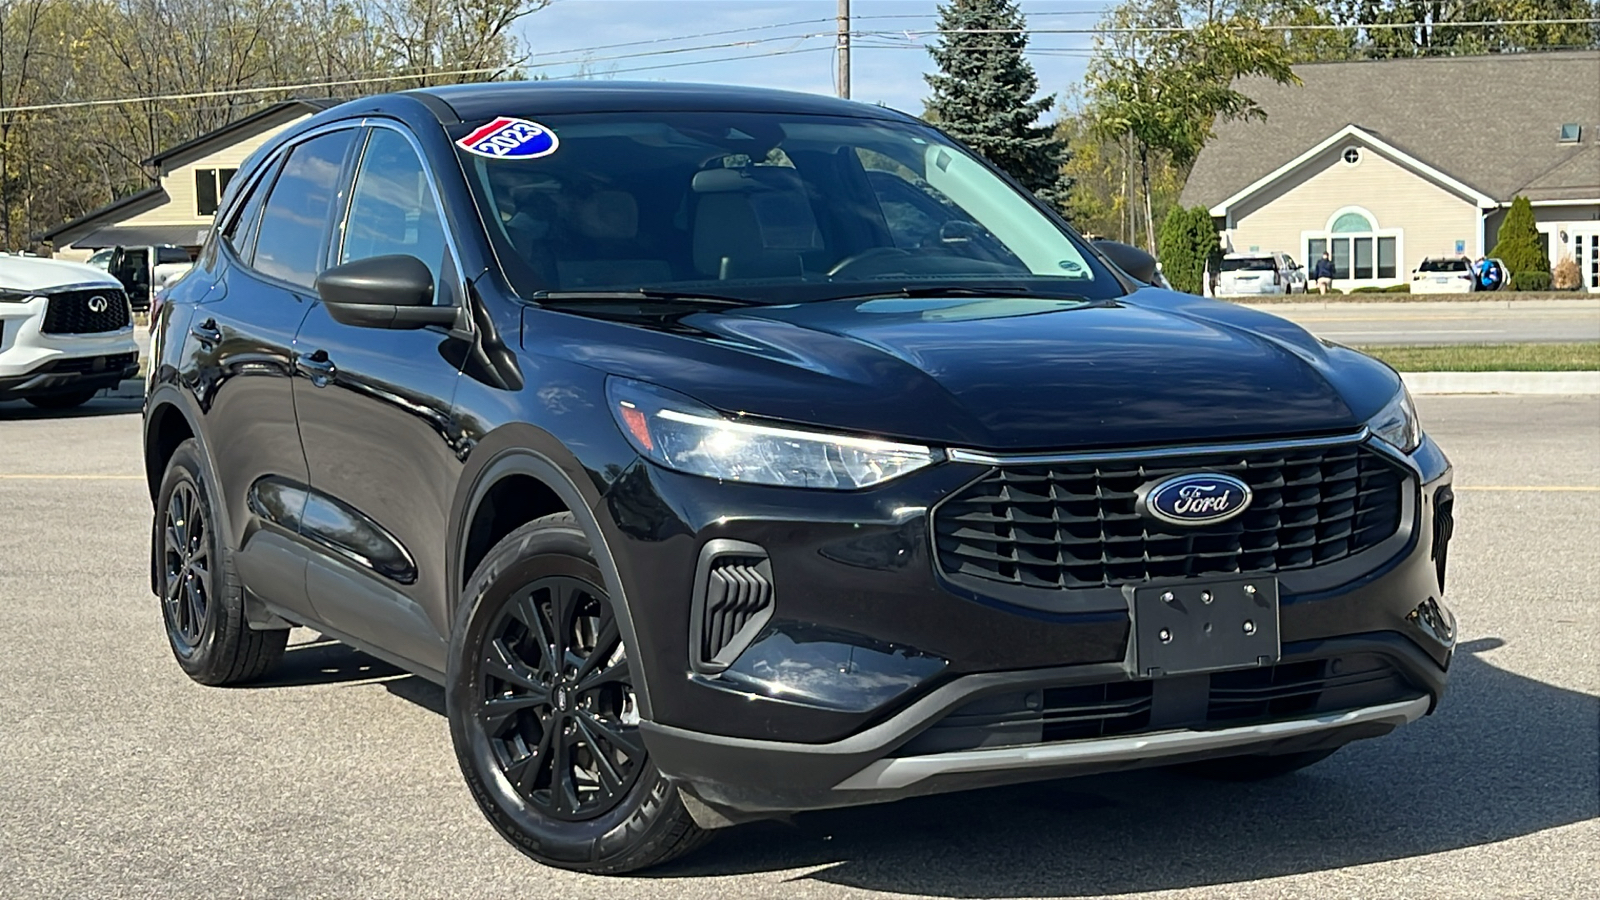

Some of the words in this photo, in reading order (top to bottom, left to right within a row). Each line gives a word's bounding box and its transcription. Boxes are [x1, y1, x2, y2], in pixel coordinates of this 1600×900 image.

[479, 123, 543, 156] 2023
[1174, 485, 1230, 514] Ford
[625, 778, 669, 839] ELLY
